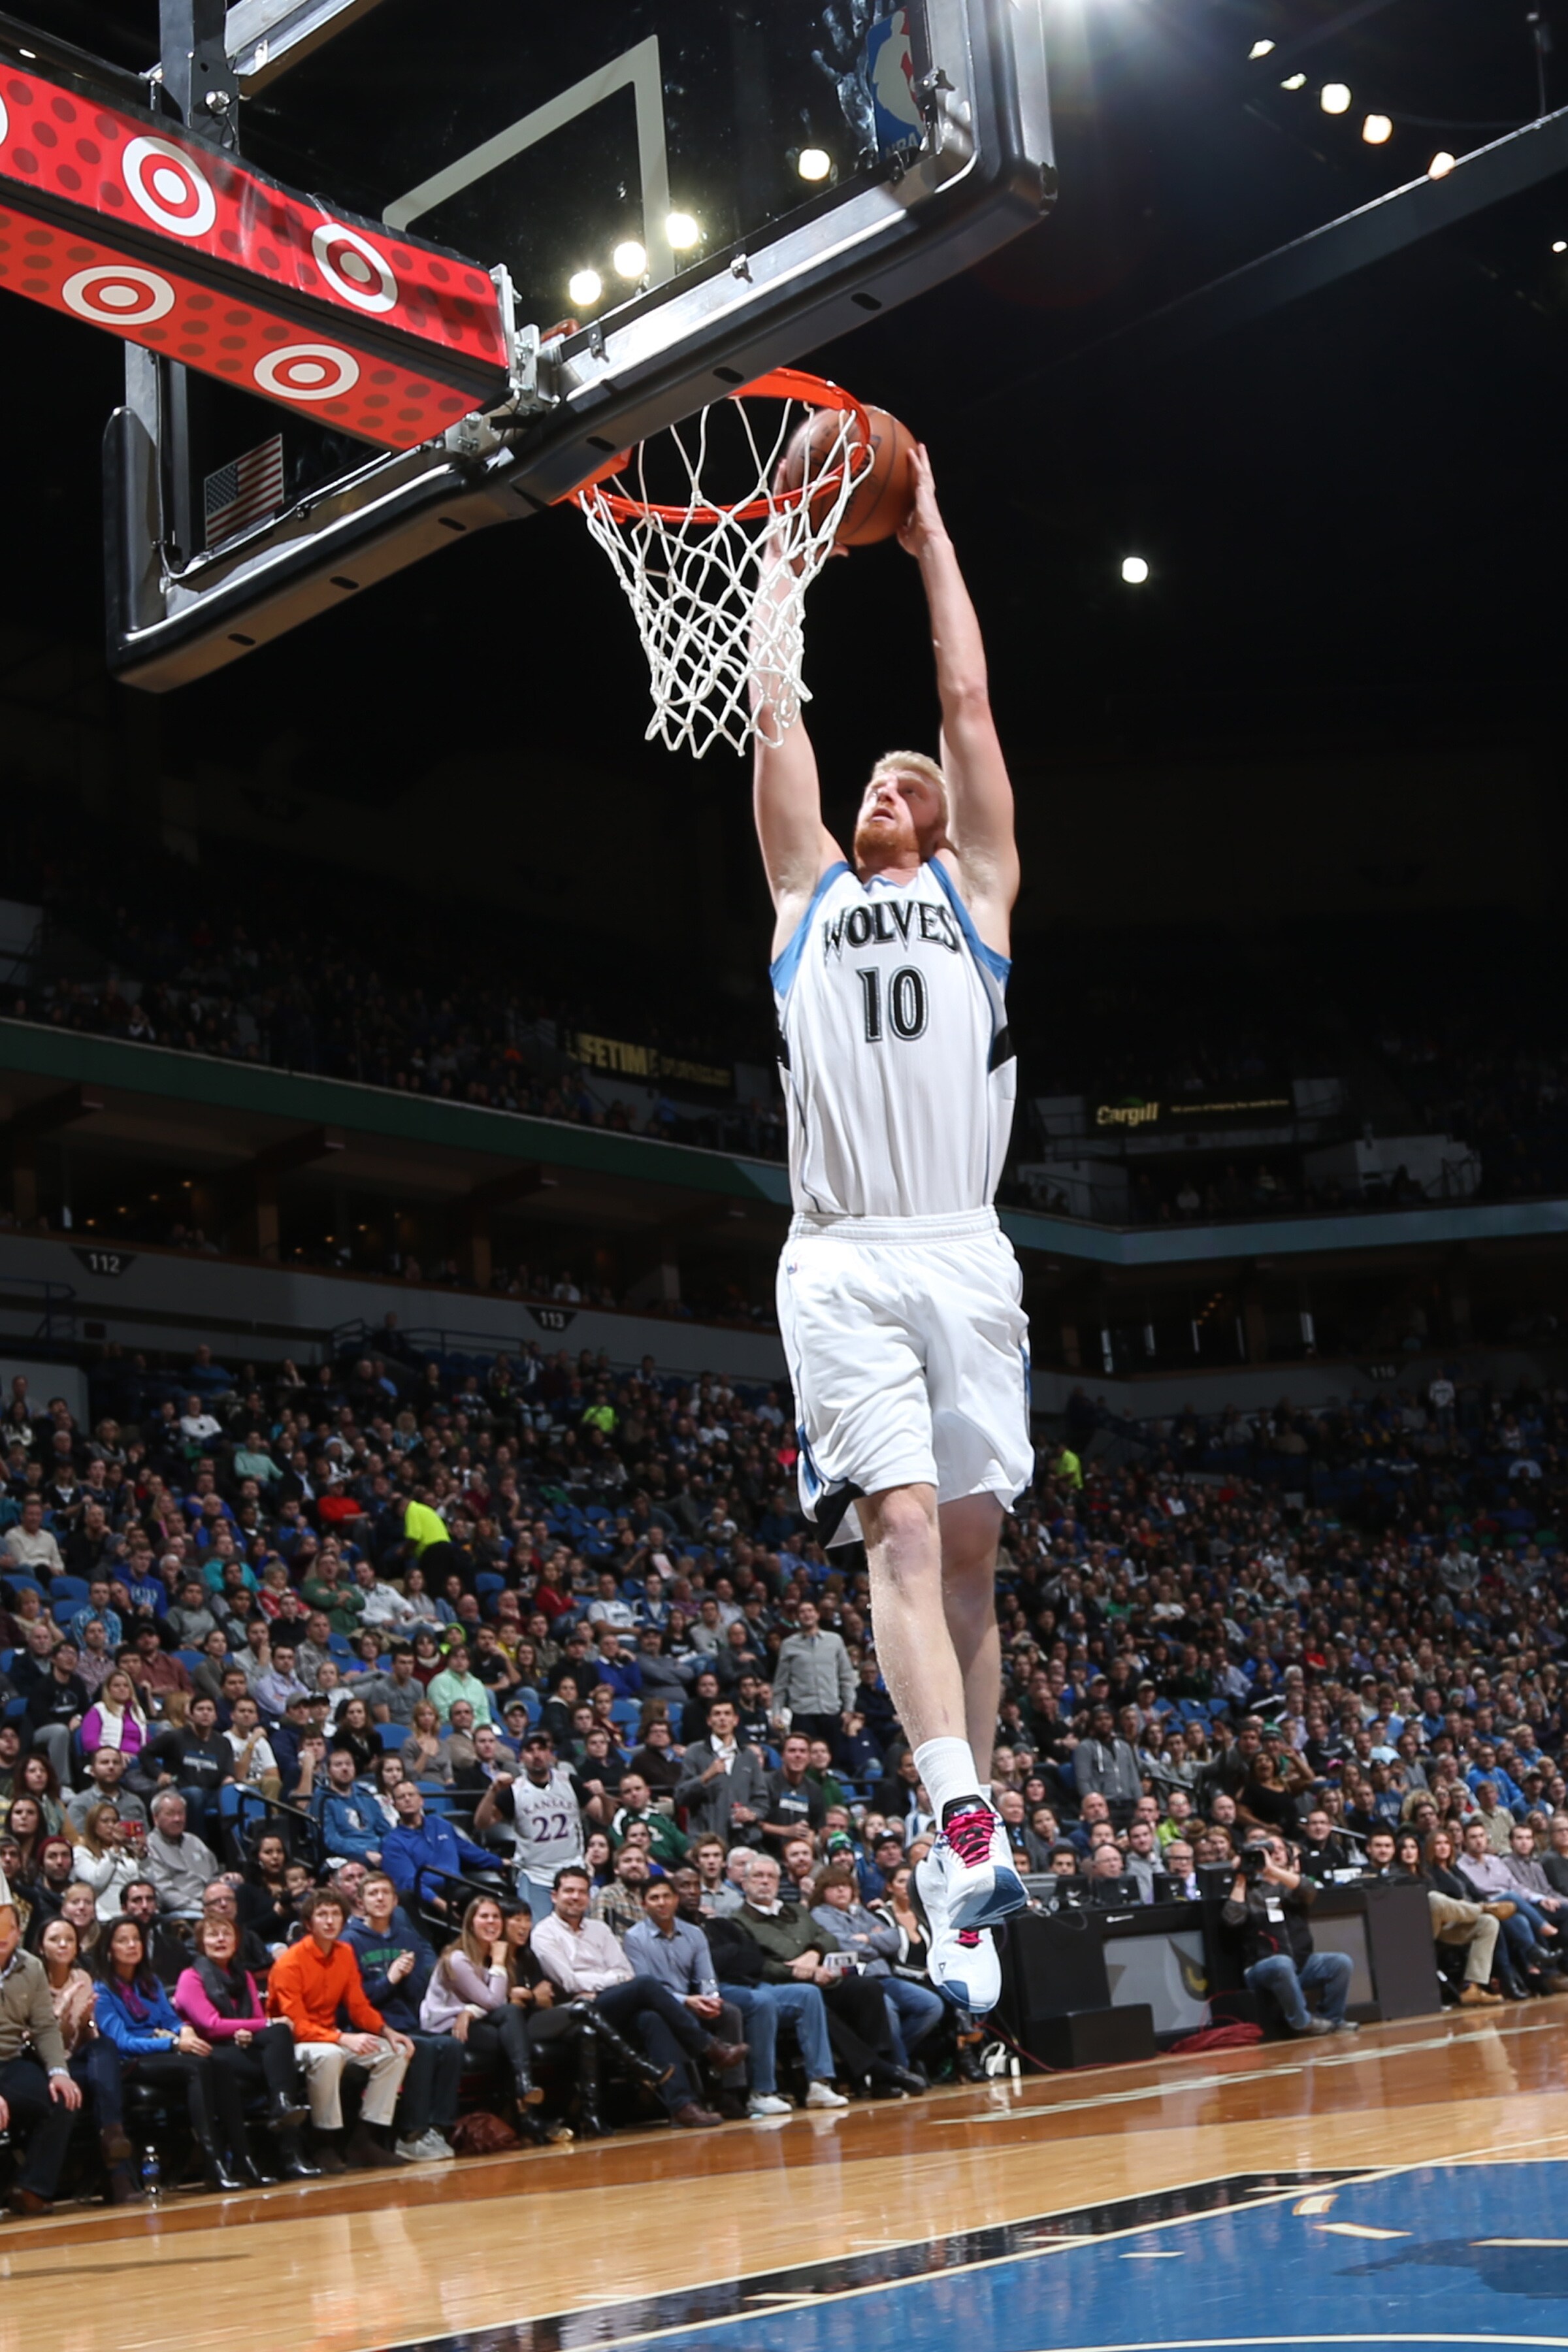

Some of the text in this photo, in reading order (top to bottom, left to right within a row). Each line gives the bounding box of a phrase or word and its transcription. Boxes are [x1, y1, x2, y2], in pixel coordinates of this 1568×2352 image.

[824, 900, 961, 966] WOLVES
[856, 965, 928, 1043] 10
[1096, 1102, 1159, 1127] Cargill
[89, 1253, 120, 1273] 112
[540, 1311, 565, 1328] 113
[532, 1814, 568, 1842] 22
